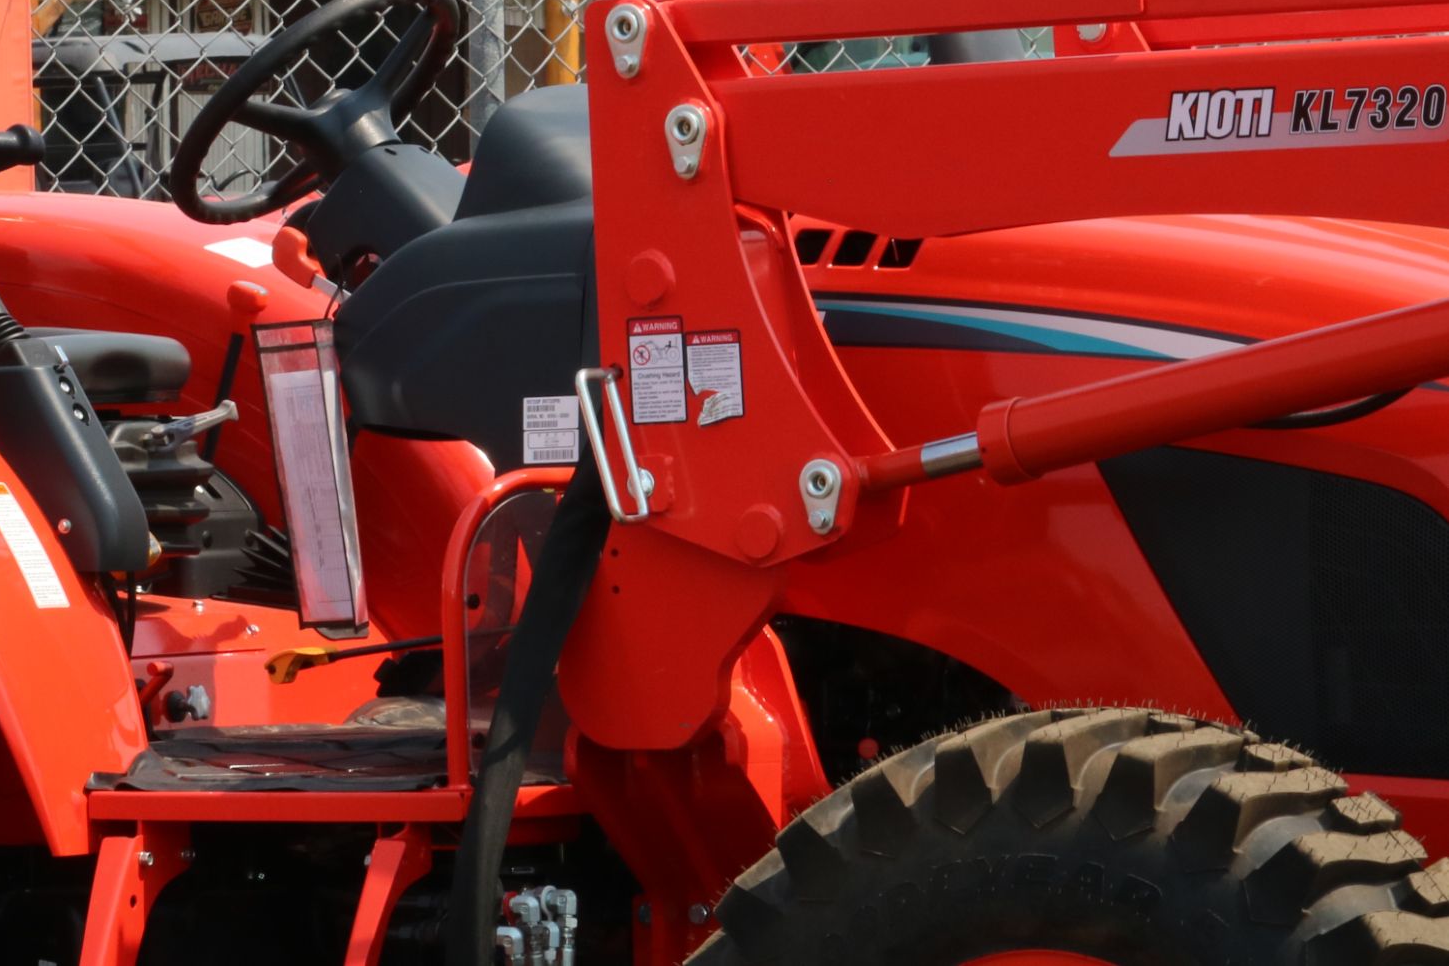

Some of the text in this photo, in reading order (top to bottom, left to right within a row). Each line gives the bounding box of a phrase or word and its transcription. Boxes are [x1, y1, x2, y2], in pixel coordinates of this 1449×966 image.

[1165, 84, 1447, 141] KIOTI KL7320
[642, 321, 678, 331] WARNING
[700, 334, 733, 343] WARNING
